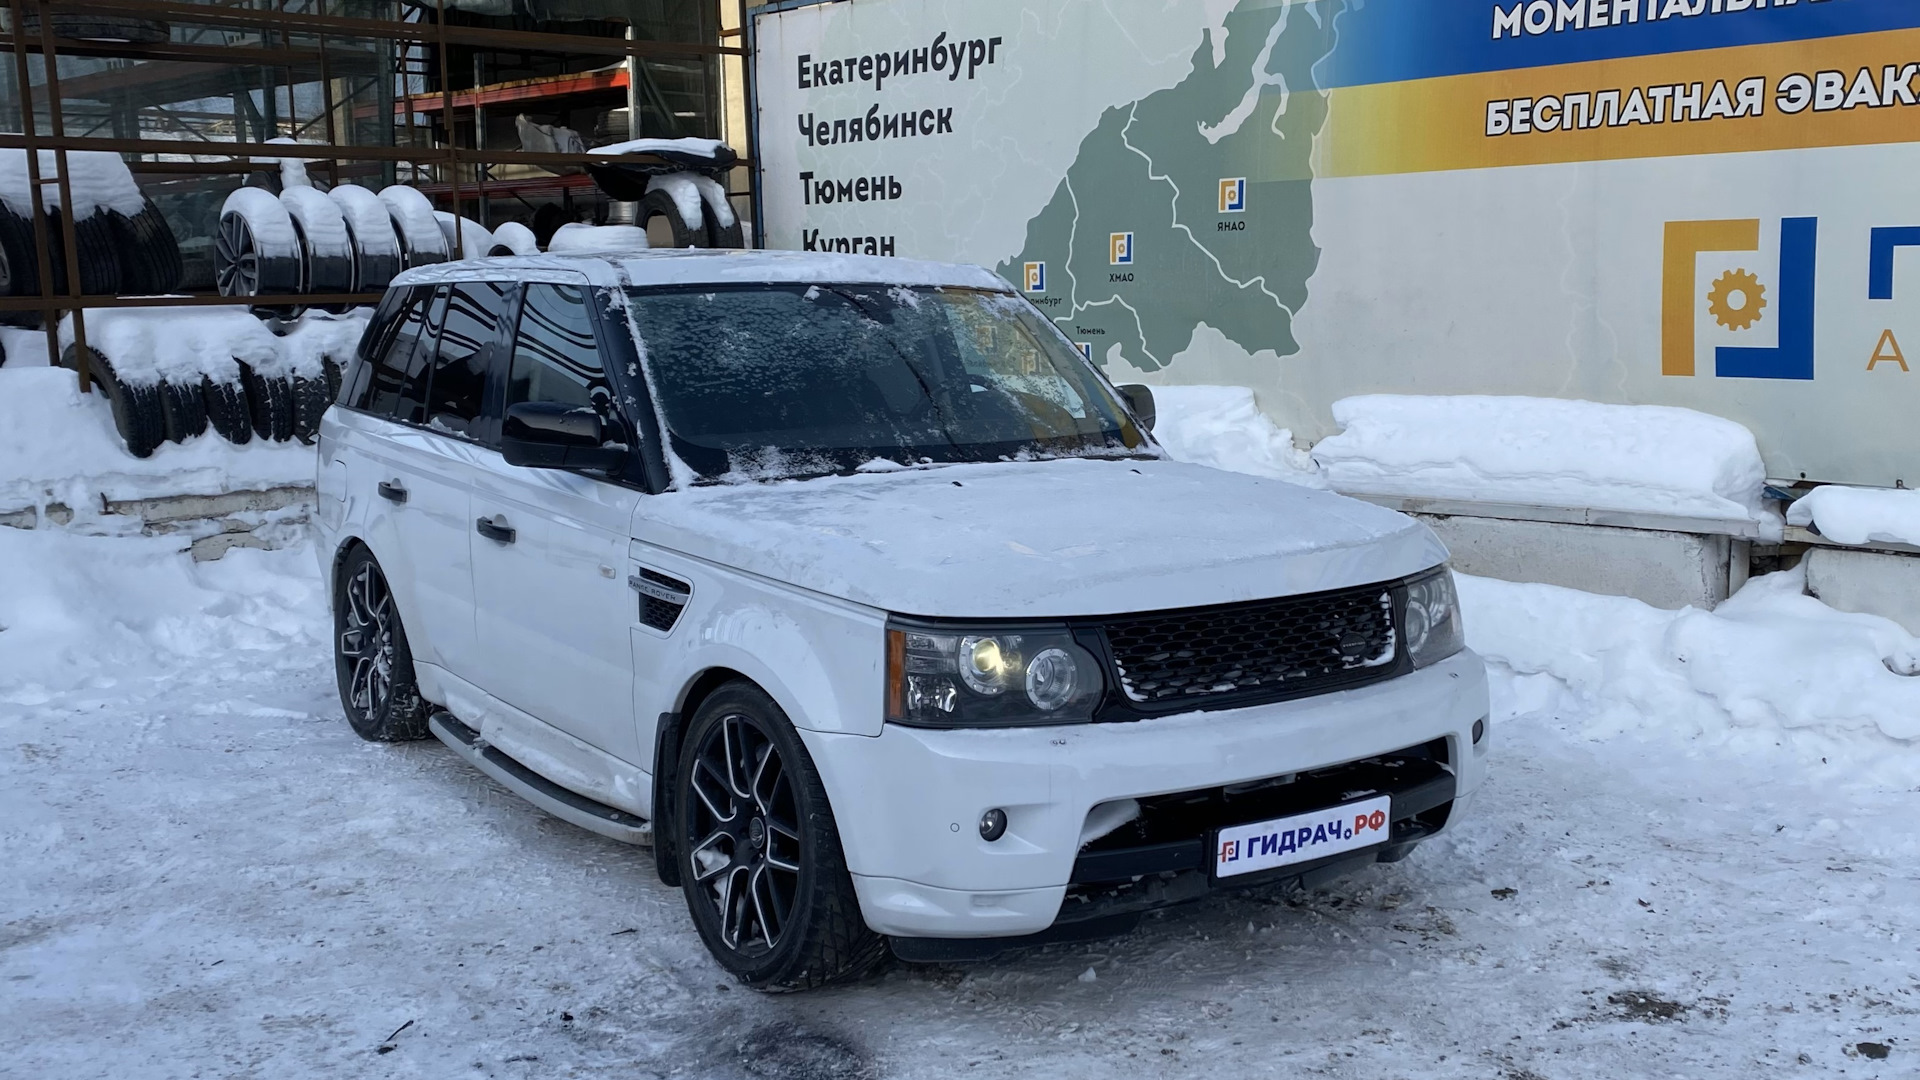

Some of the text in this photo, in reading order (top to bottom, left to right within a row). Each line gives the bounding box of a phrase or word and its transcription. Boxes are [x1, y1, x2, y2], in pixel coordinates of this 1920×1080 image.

[797, 32, 1003, 91] Екатеринбург
[1485, 62, 1920, 137] БЕСПЛАТНАЯ ЭВАК
[797, 103, 953, 147] Челябинск
[800, 171, 902, 205] Тюмень
[1217, 221, 1246, 232] ЯНАО
[1109, 272, 1134, 283] ХМАО
[1076, 326, 1106, 335] Тюмень
[651, 588, 676, 601] ROVER
